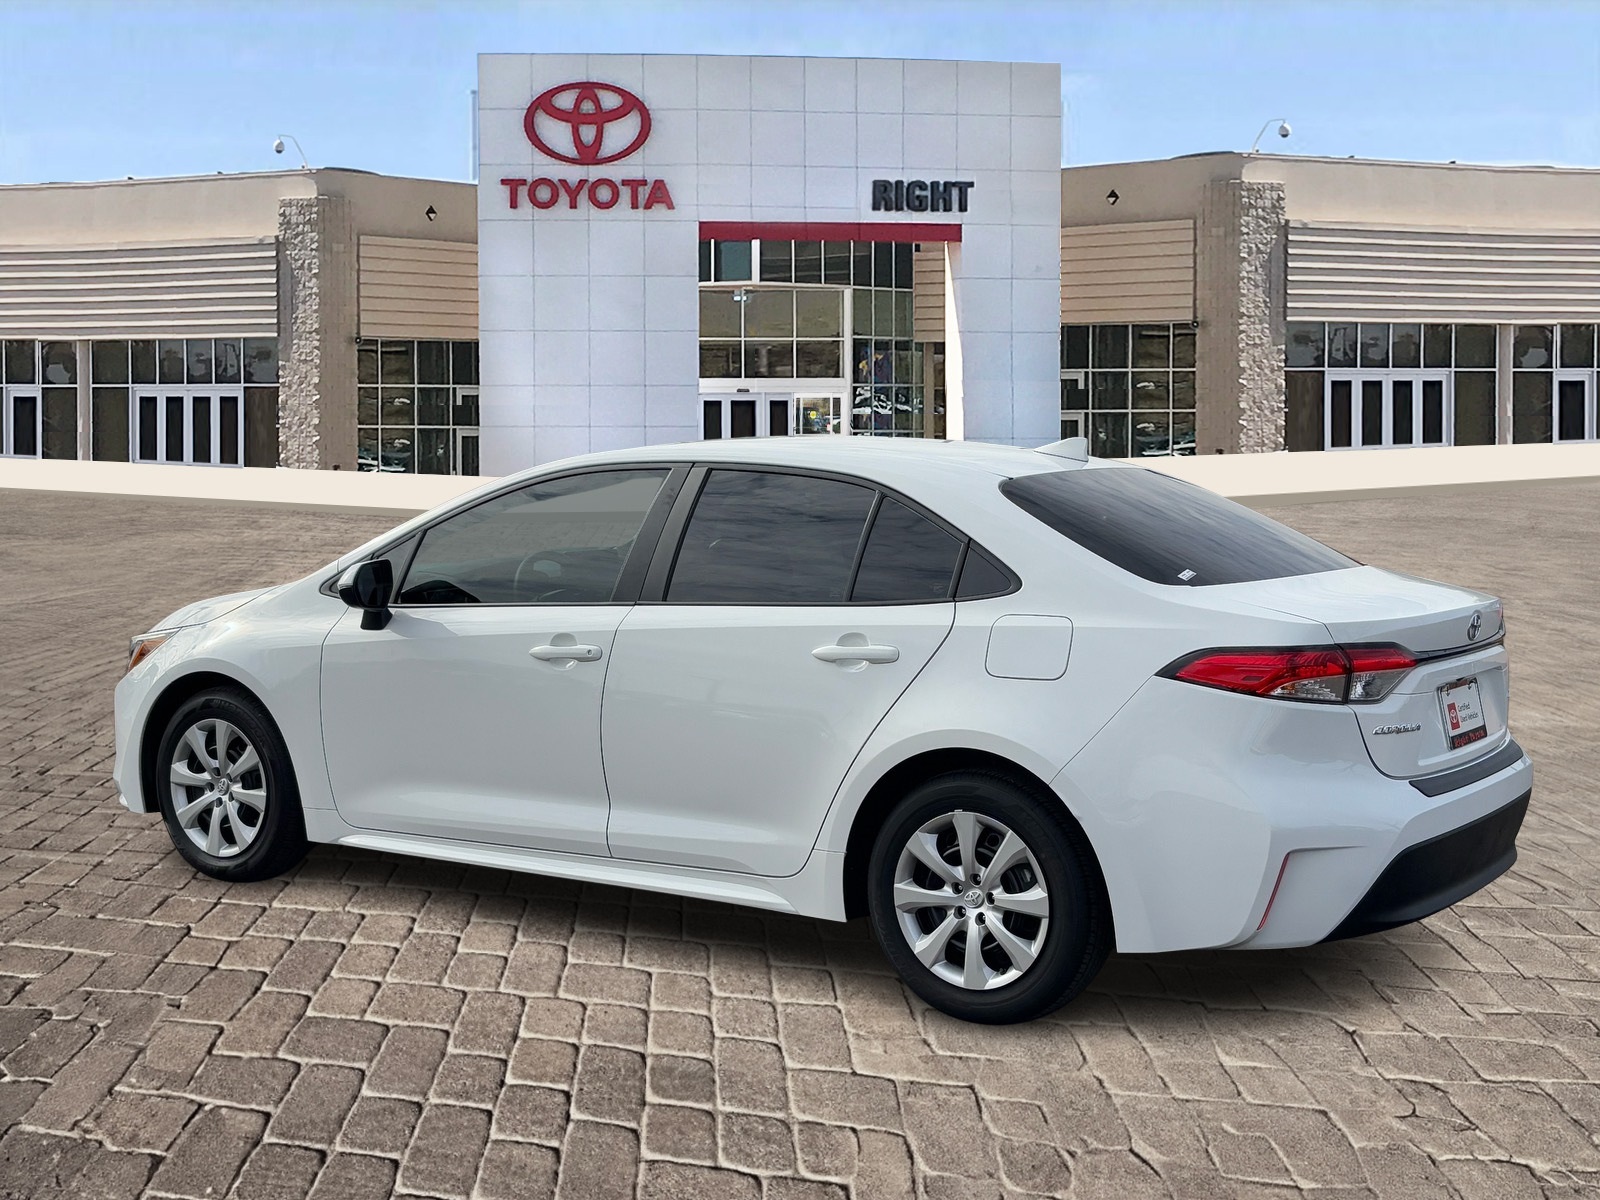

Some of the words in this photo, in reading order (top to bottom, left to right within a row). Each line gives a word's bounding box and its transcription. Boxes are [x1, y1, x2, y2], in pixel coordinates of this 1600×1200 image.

[501, 178, 675, 211] TOYOTA
[871, 179, 975, 213] RIGHT
[1457, 702, 1471, 712] Certified
[1468, 711, 1479, 721] Vehicles
